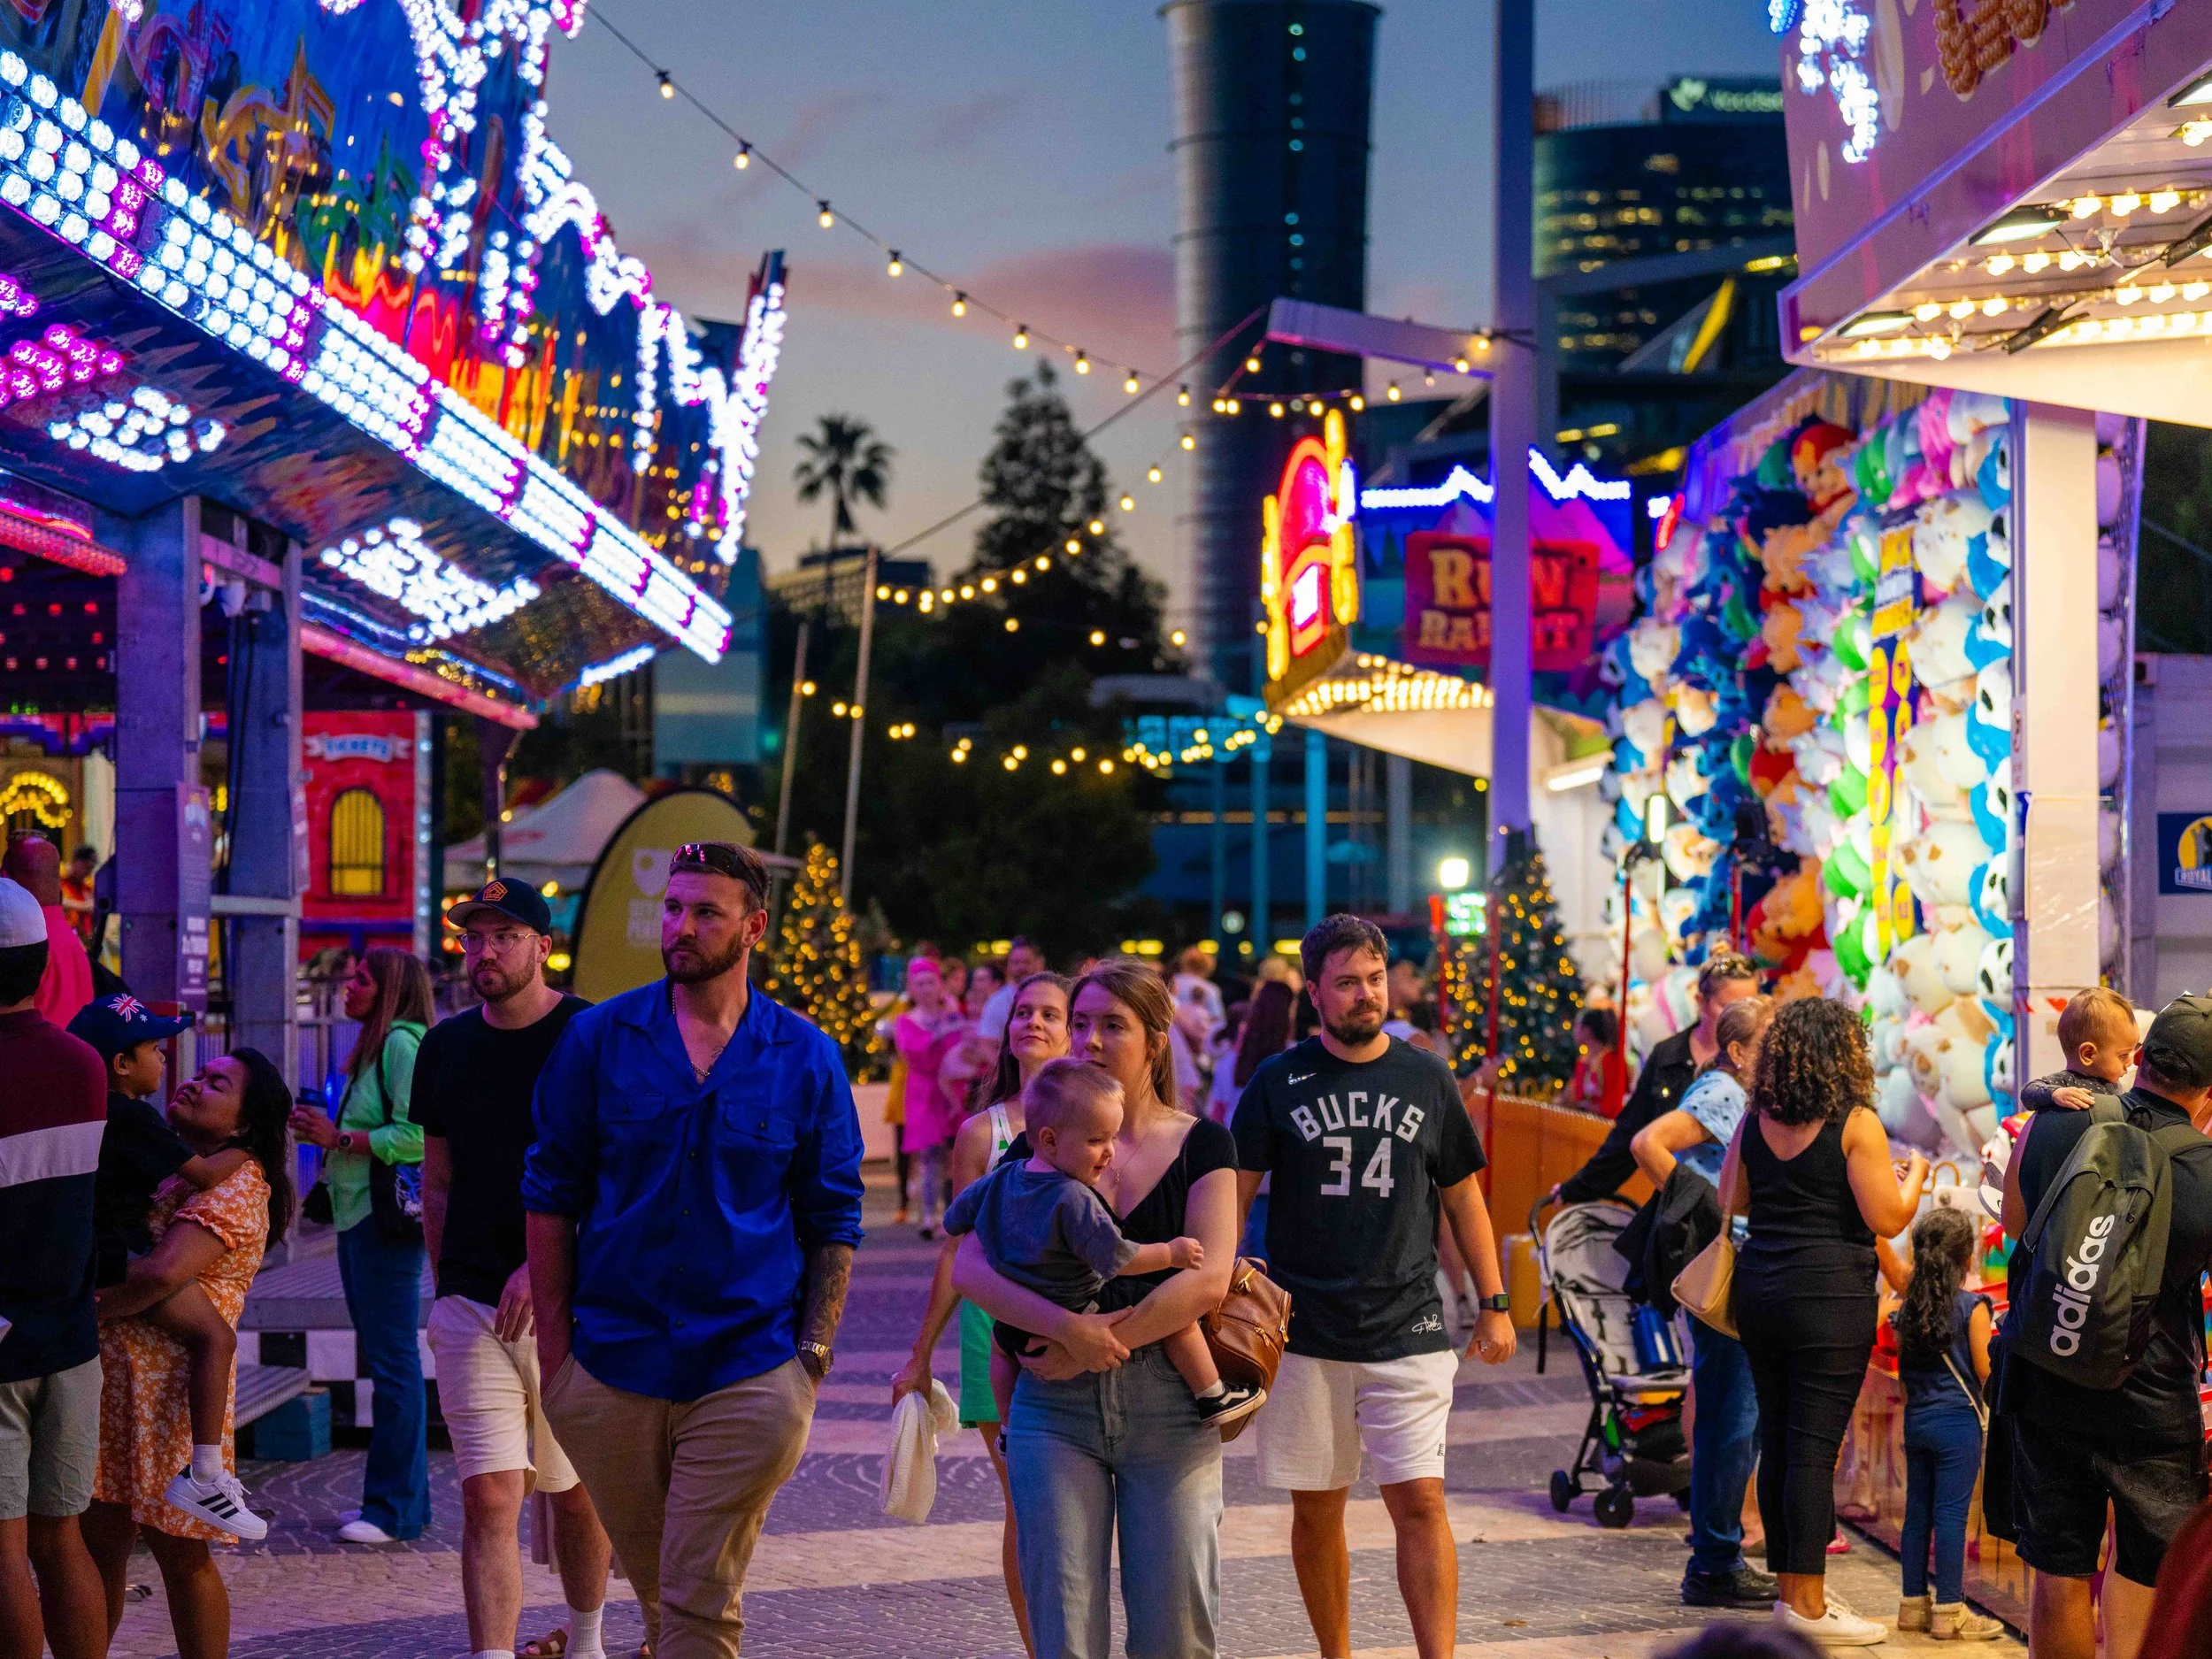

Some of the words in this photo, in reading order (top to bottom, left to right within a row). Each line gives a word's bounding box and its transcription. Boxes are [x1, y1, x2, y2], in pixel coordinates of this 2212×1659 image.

[1290, 1091, 1425, 1143] BUCKS
[1320, 1136, 1395, 1198] 34
[2050, 1214, 2116, 1356] adidas
